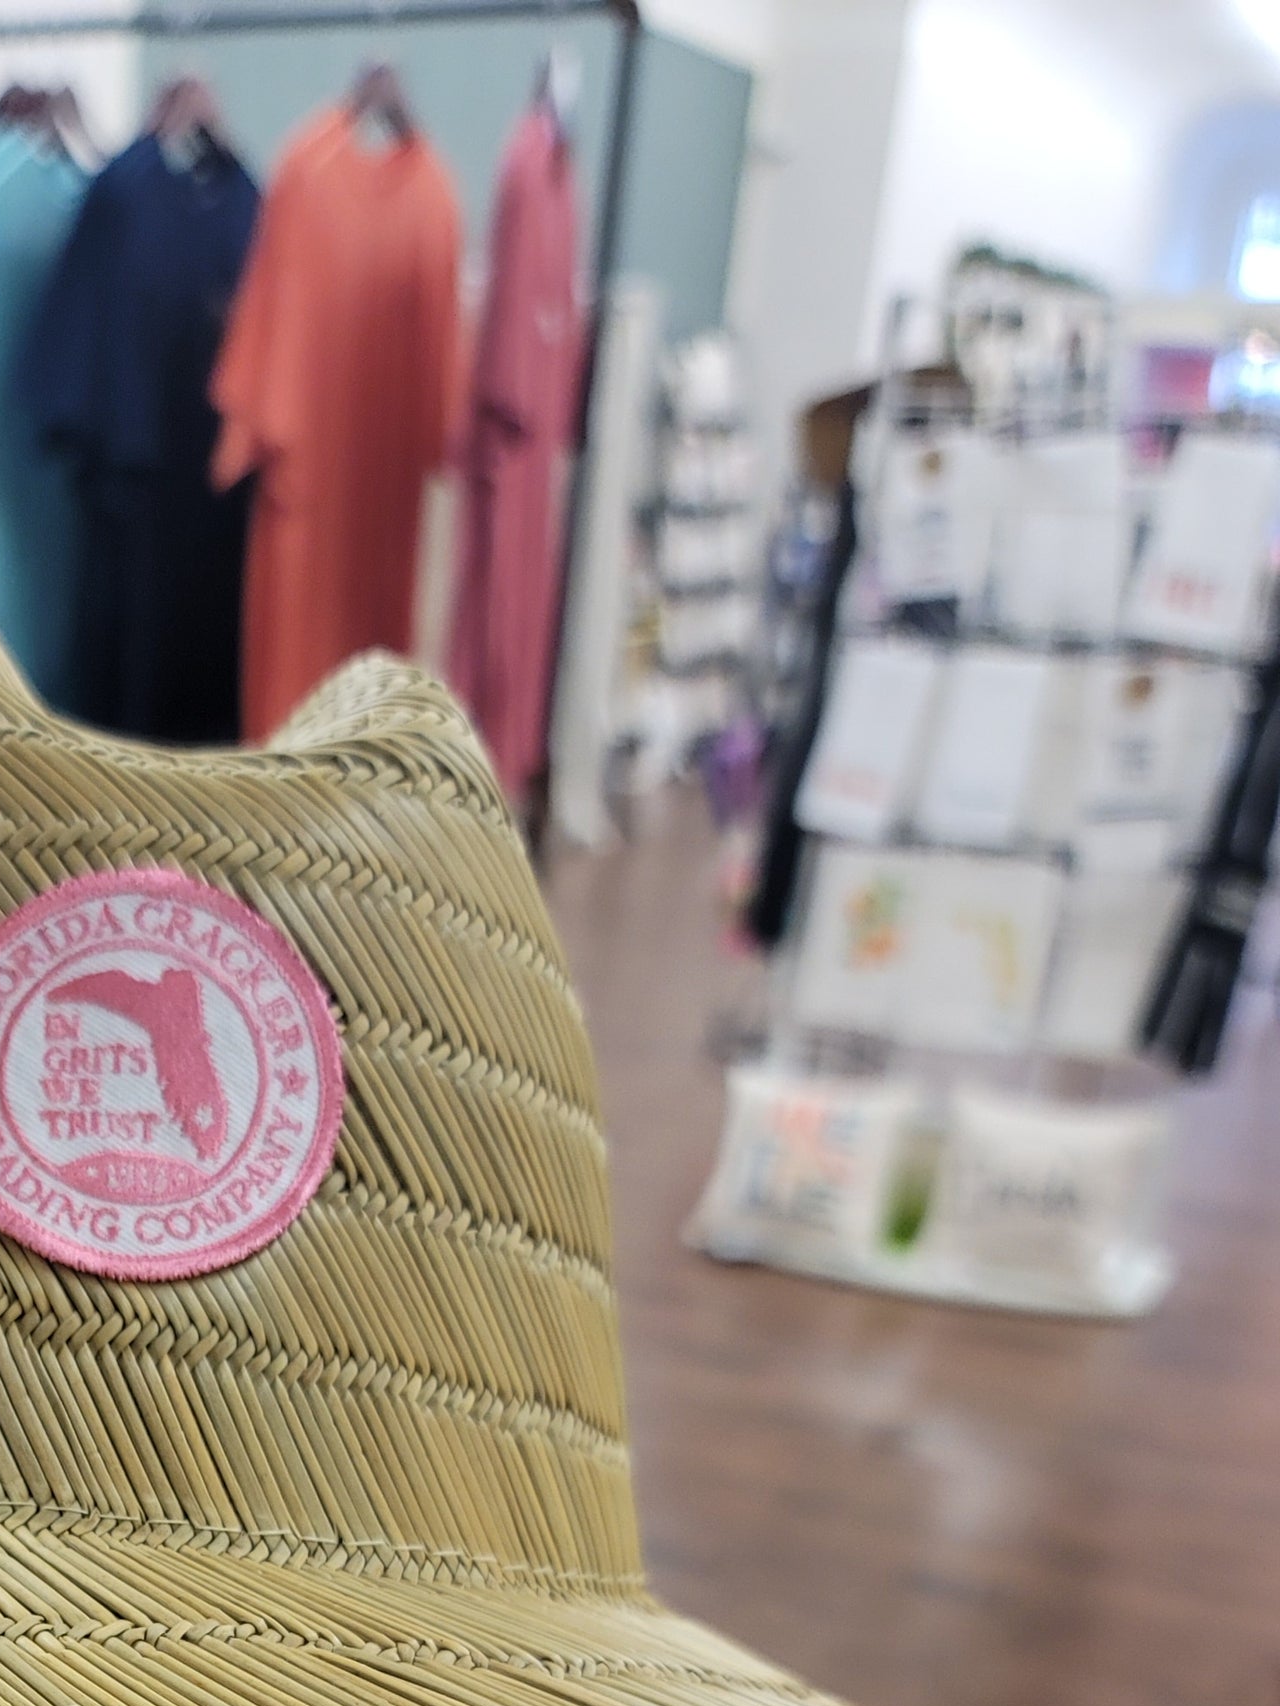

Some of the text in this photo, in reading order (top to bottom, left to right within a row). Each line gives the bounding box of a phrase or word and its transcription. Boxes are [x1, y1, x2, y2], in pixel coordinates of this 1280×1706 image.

[133, 899, 305, 1059] CRACKER
[44, 1012, 81, 1042] IN
[42, 1043, 149, 1076] GRITS
[39, 1075, 102, 1106] WE
[39, 1110, 161, 1143] TRUST
[133, 1106, 303, 1246] COMPANY
